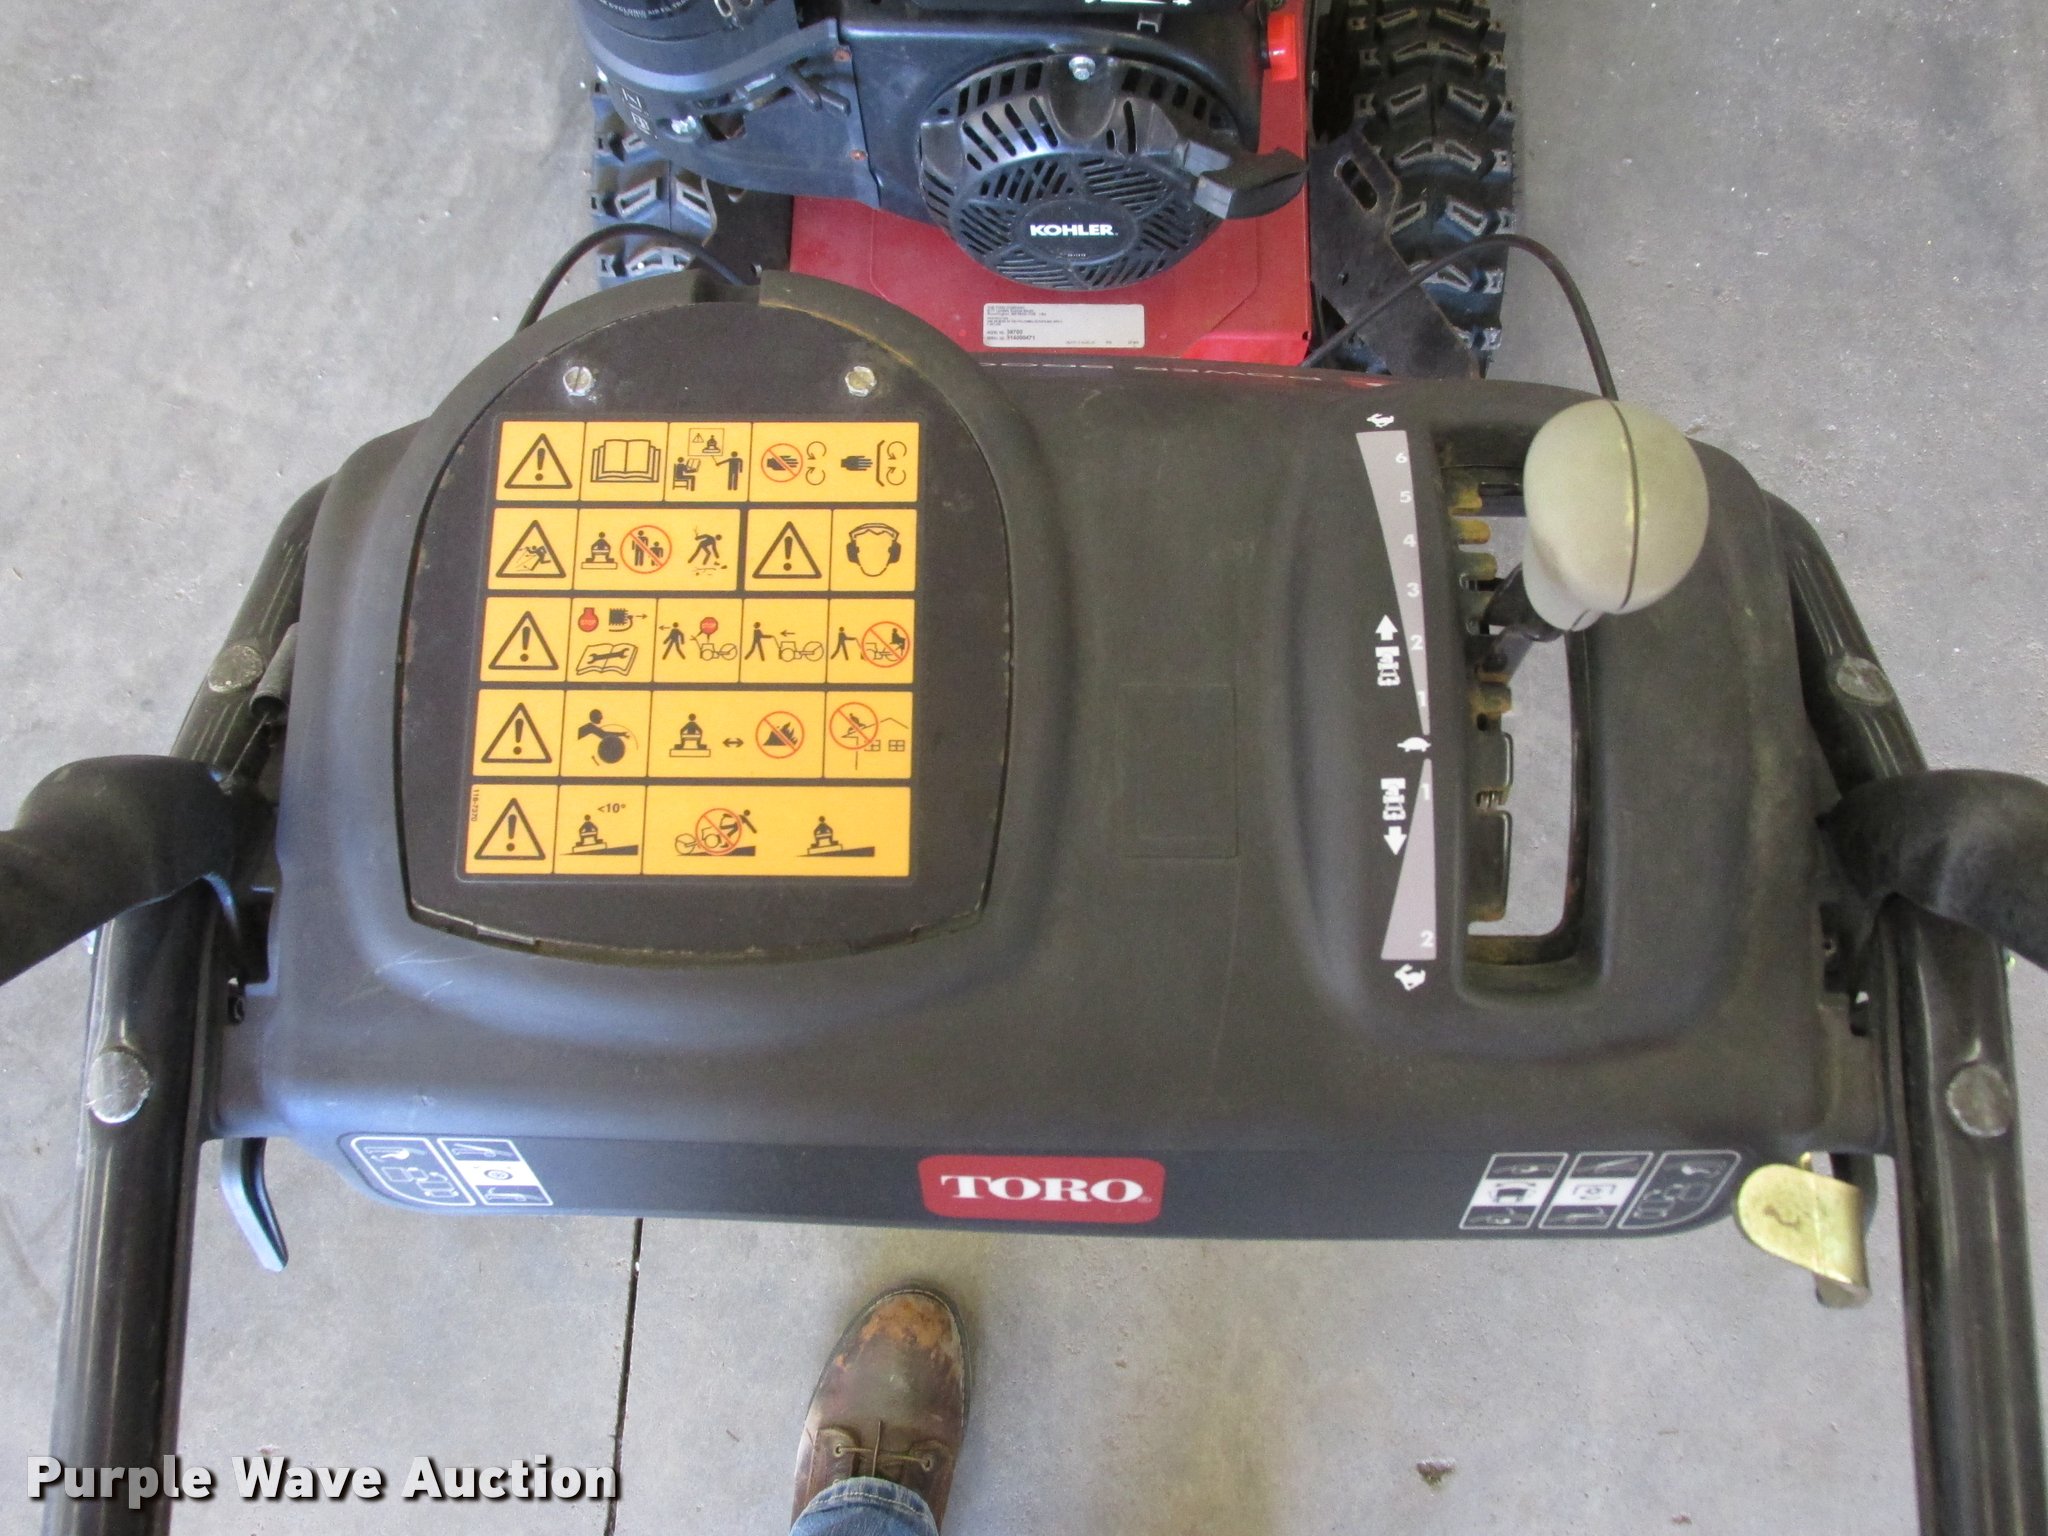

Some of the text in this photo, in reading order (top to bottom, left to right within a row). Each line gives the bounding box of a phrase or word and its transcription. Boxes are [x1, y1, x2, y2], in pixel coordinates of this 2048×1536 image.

[1030, 224, 1114, 236] KOHLER
[1395, 453, 1407, 464] 6
[1400, 491, 1412, 503] 5
[1403, 534, 1417, 547] 4
[1406, 583, 1420, 597] 3
[1410, 635, 1424, 650] 2
[1417, 691, 1426, 707] 1
[1421, 783, 1431, 800] 1
[597, 803, 626, 814] <10°
[1420, 931, 1434, 947] 2
[941, 1175, 1144, 1203] TORO
